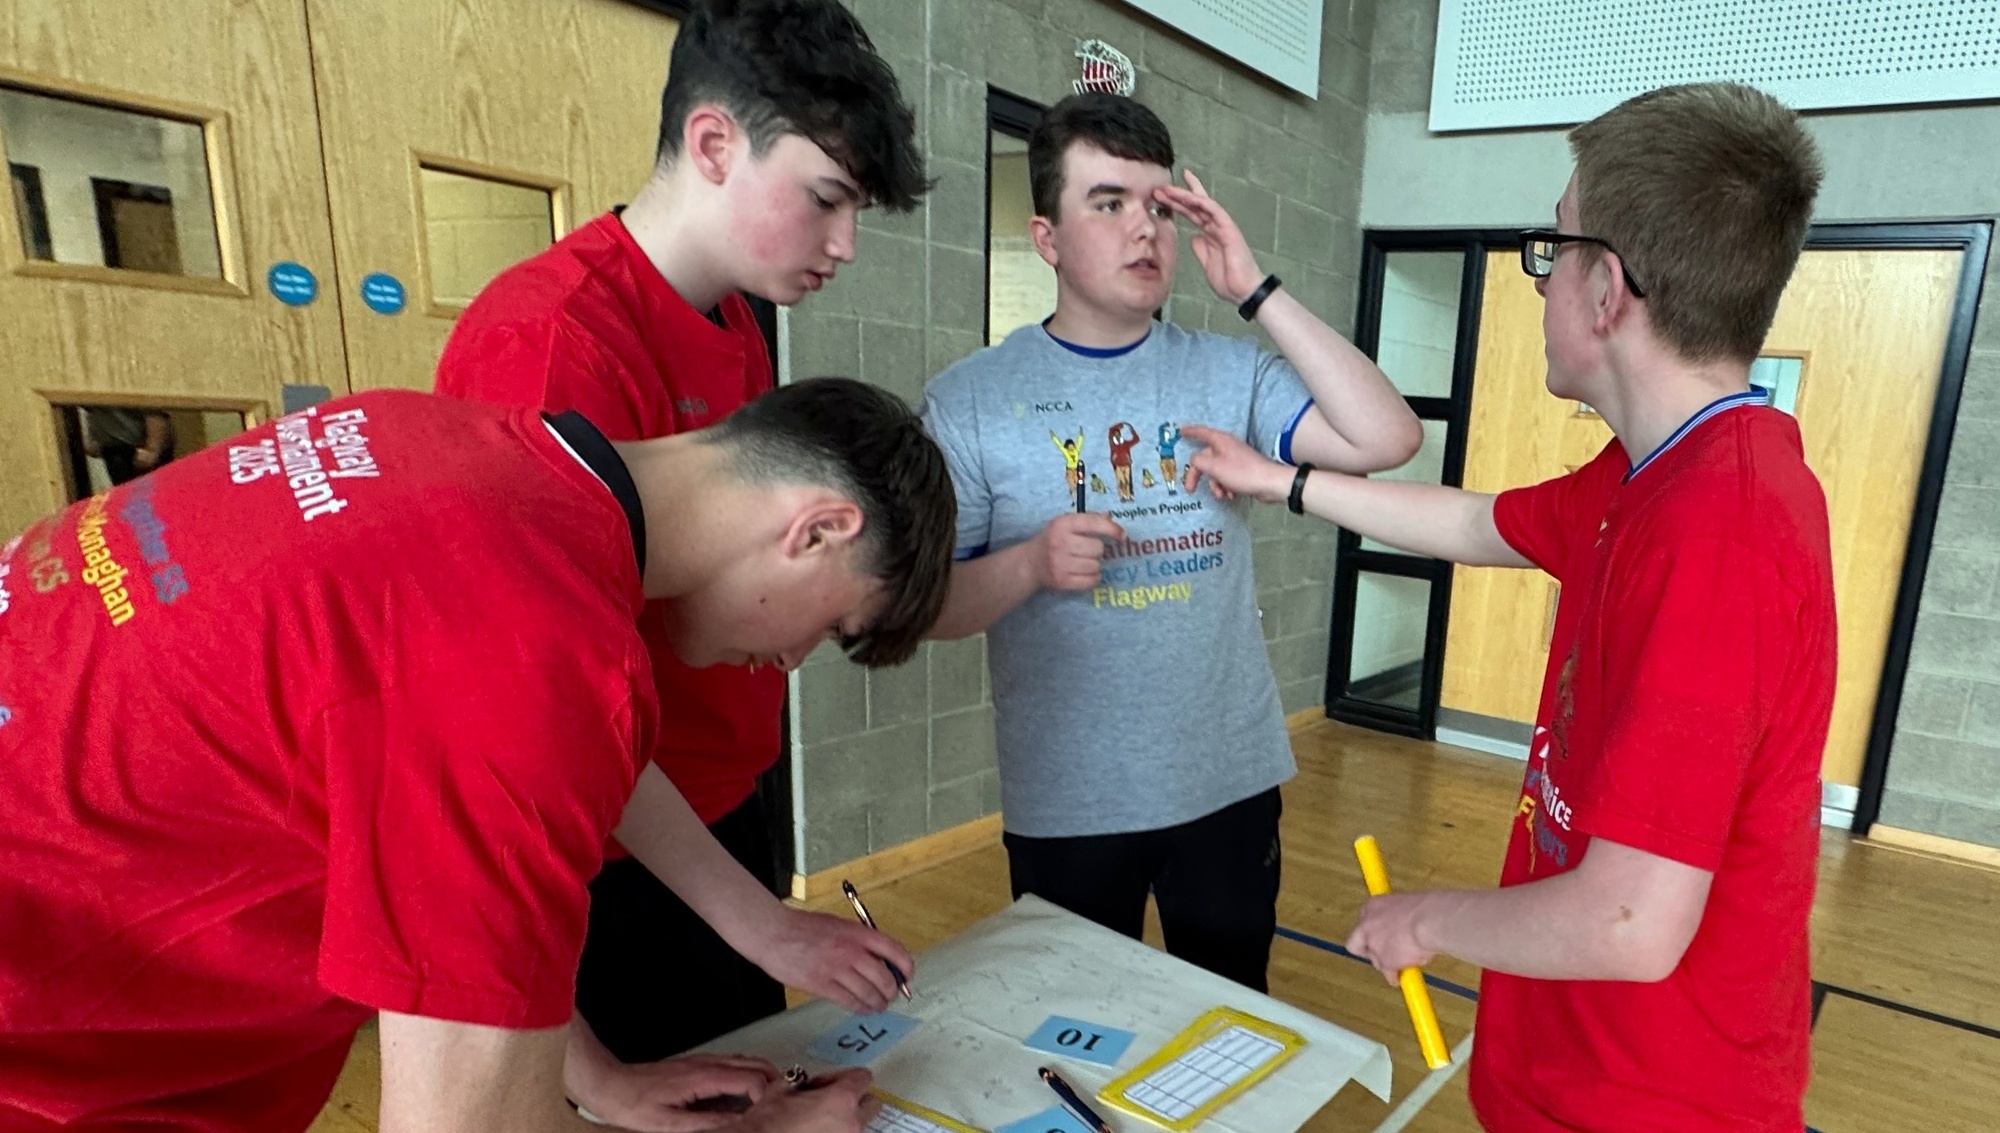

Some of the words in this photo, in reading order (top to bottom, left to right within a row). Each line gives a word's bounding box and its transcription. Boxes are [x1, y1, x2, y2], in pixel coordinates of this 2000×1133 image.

[1035, 401, 1073, 413] NCCA
[315, 408, 380, 478] Flagway
[1159, 500, 1203, 514] Project
[1103, 528, 1223, 560] athematics
[1145, 551, 1223, 579] Leaders
[1093, 581, 1192, 608] Flagway
[837, 1023, 888, 1052] 75
[1056, 1027, 1105, 1052] 10
